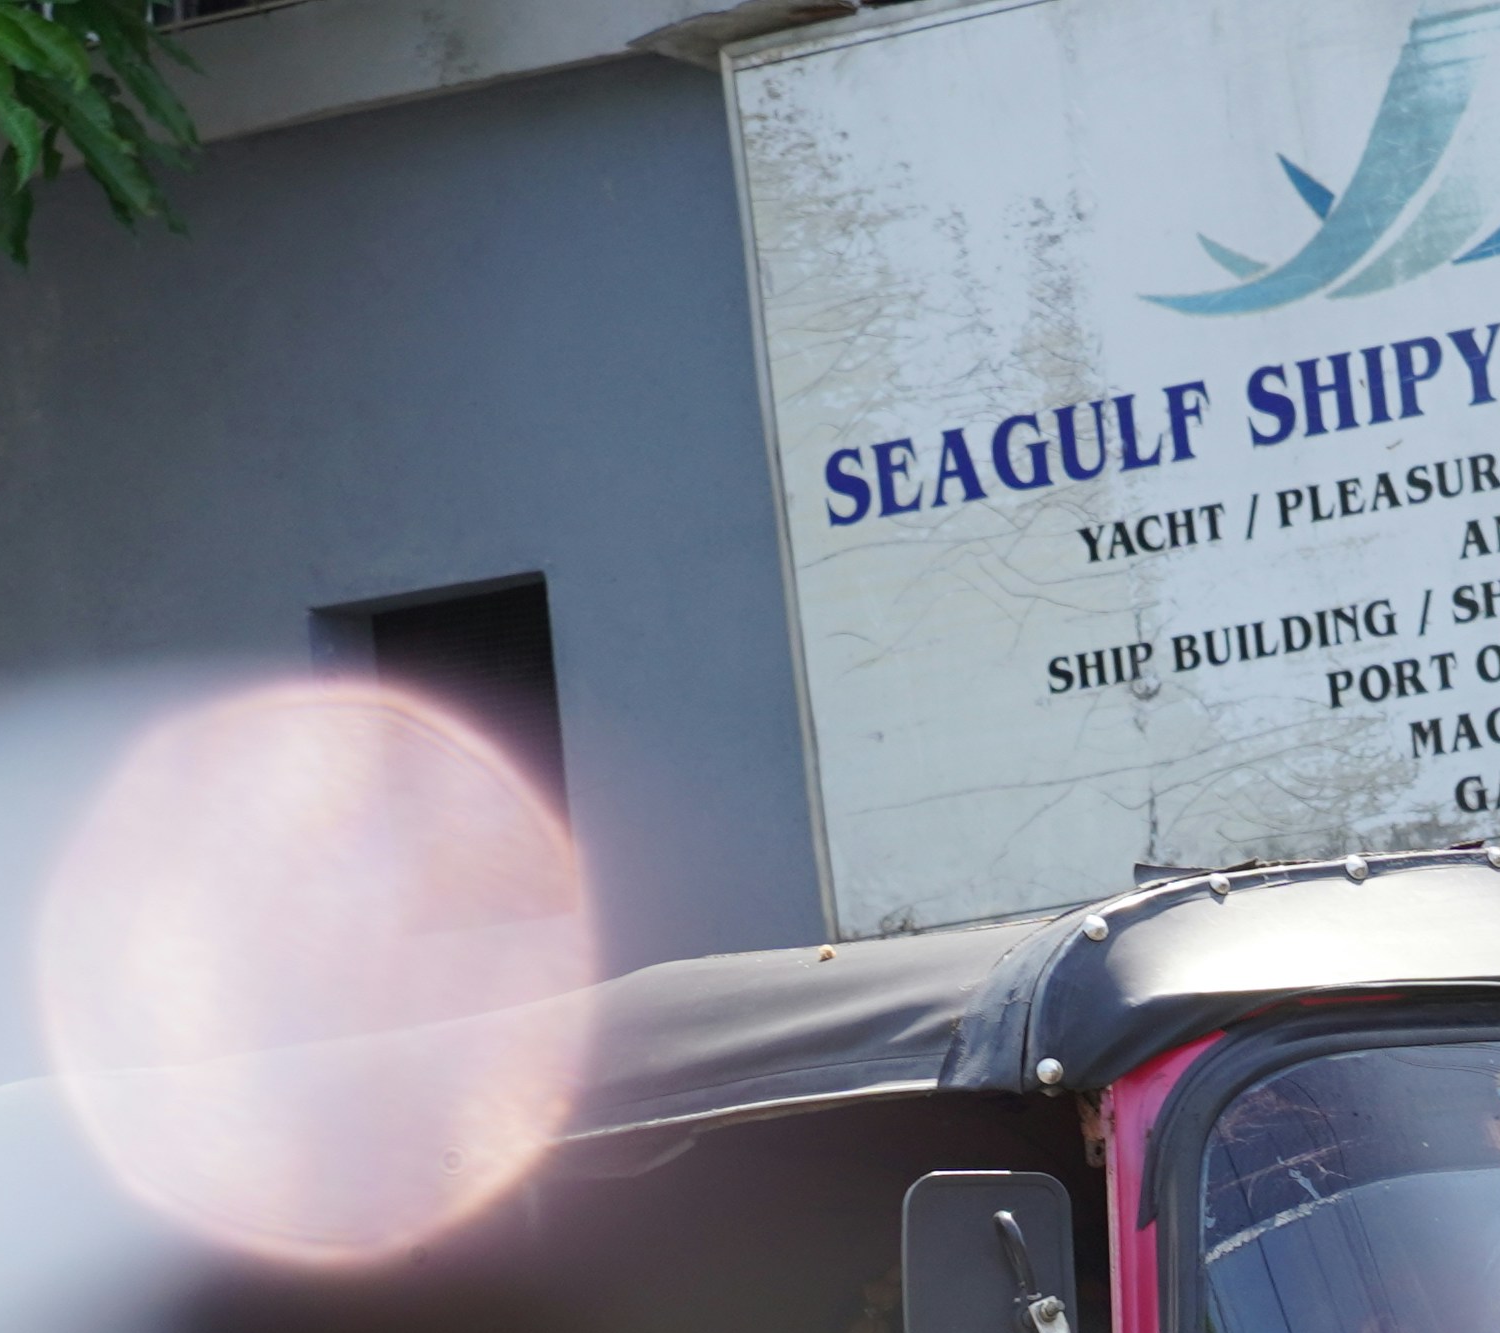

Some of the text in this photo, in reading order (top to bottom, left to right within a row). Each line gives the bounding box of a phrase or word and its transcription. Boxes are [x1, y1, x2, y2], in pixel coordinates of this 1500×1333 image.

[825, 379, 1211, 527] SEAGULF
[1076, 501, 1226, 564] YACHT
[1047, 640, 1155, 696] SHIP
[1171, 597, 1398, 673] BUILDING
[1325, 651, 1458, 710] PORT
